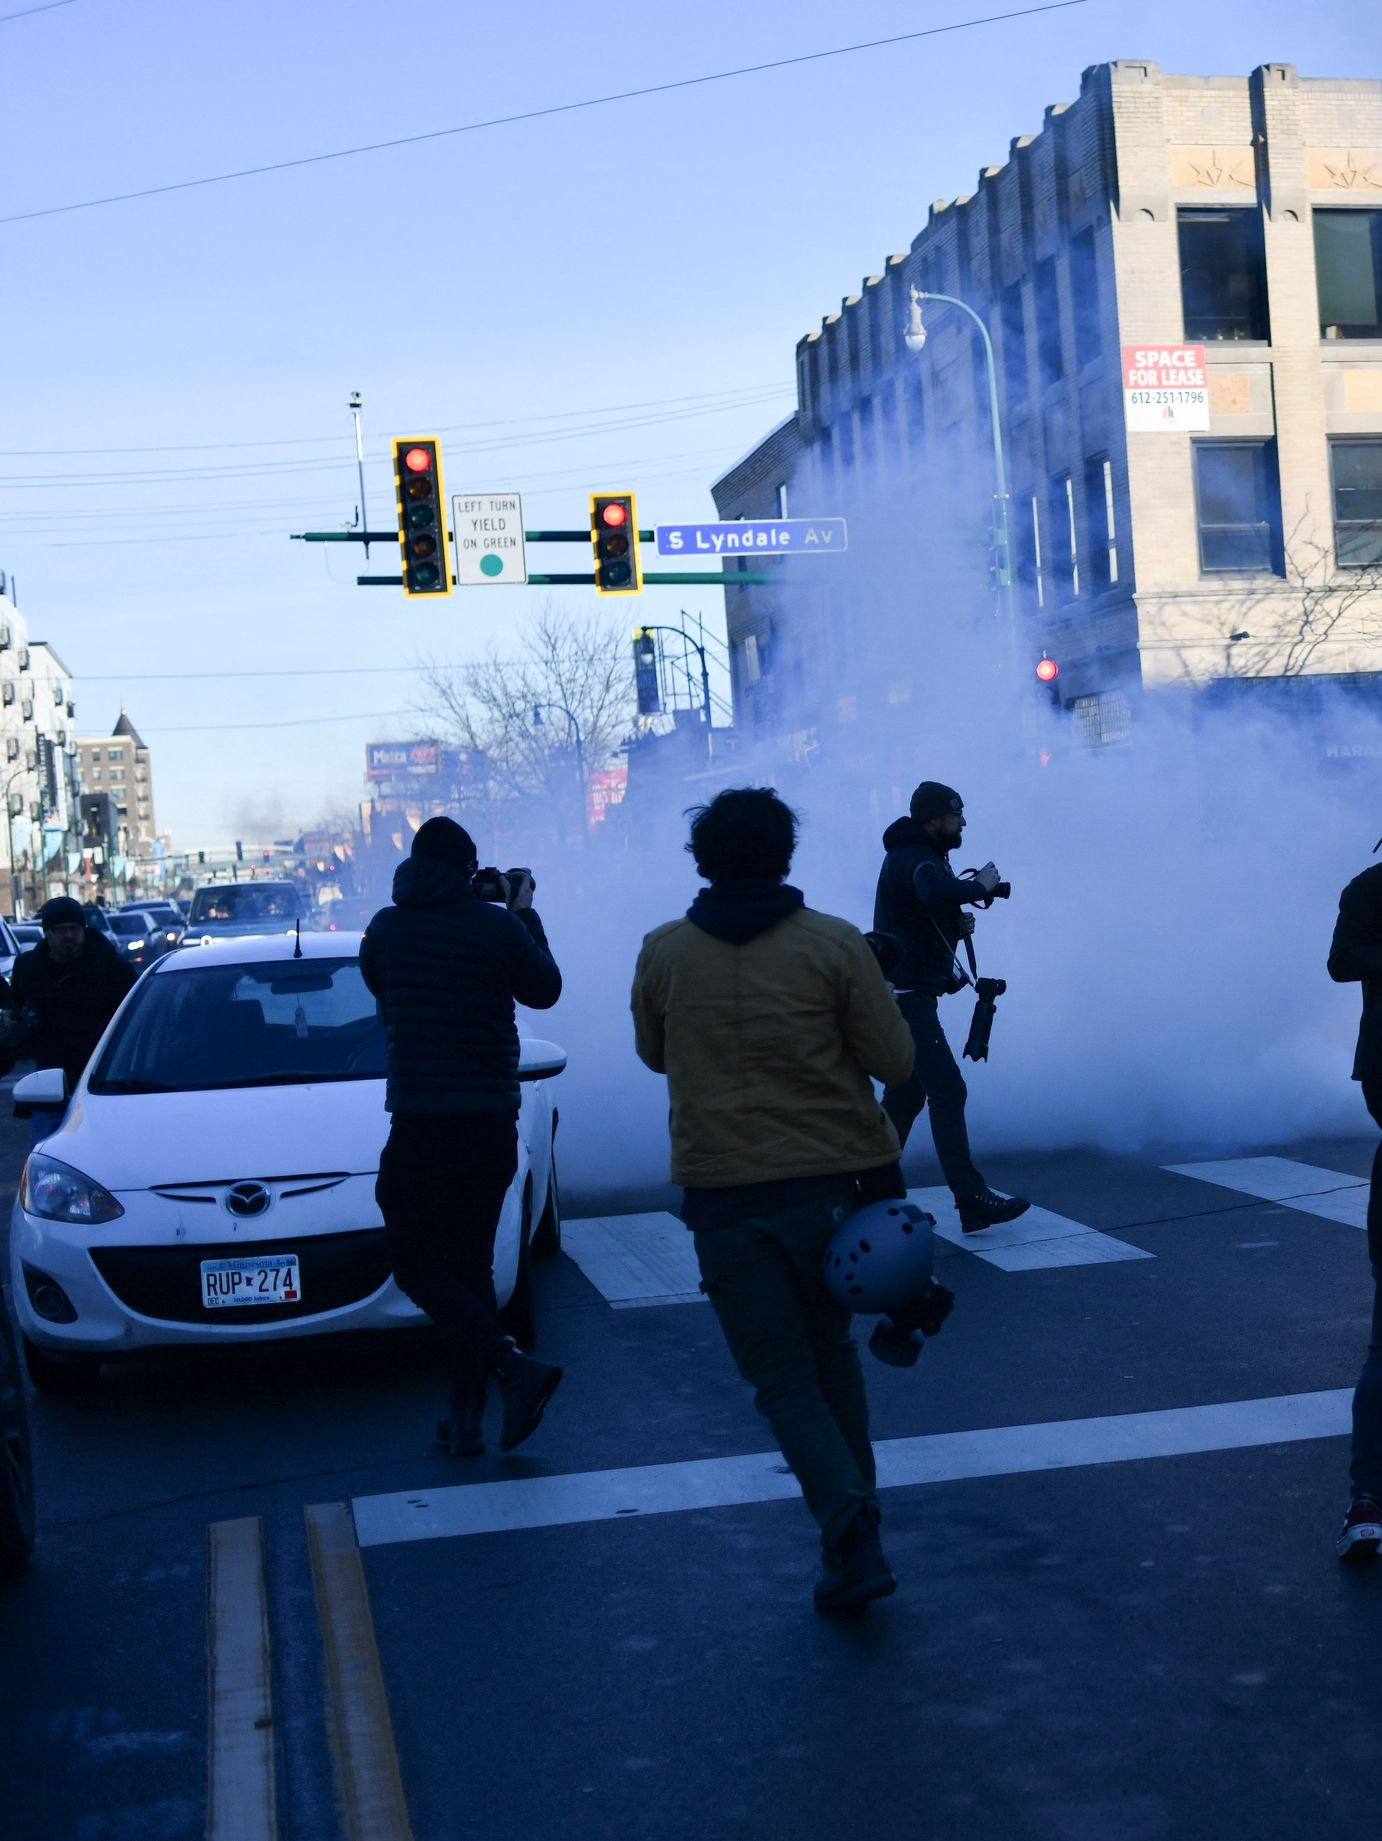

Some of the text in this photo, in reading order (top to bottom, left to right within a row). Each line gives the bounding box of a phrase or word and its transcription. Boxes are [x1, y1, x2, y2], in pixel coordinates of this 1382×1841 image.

[1134, 350, 1197, 368] SPACE
[1128, 368, 1205, 386] FOR LEASE
[1131, 391, 1204, 404] 612-251-1796
[458, 500, 516, 512] LEFT TURN
[471, 518, 506, 531] YIELD
[463, 537, 516, 549] ON GREEN
[668, 528, 832, 552] S Lyndale Av
[227, 1260, 273, 1271] Minnesota
[206, 1268, 293, 1296] RUP 274
